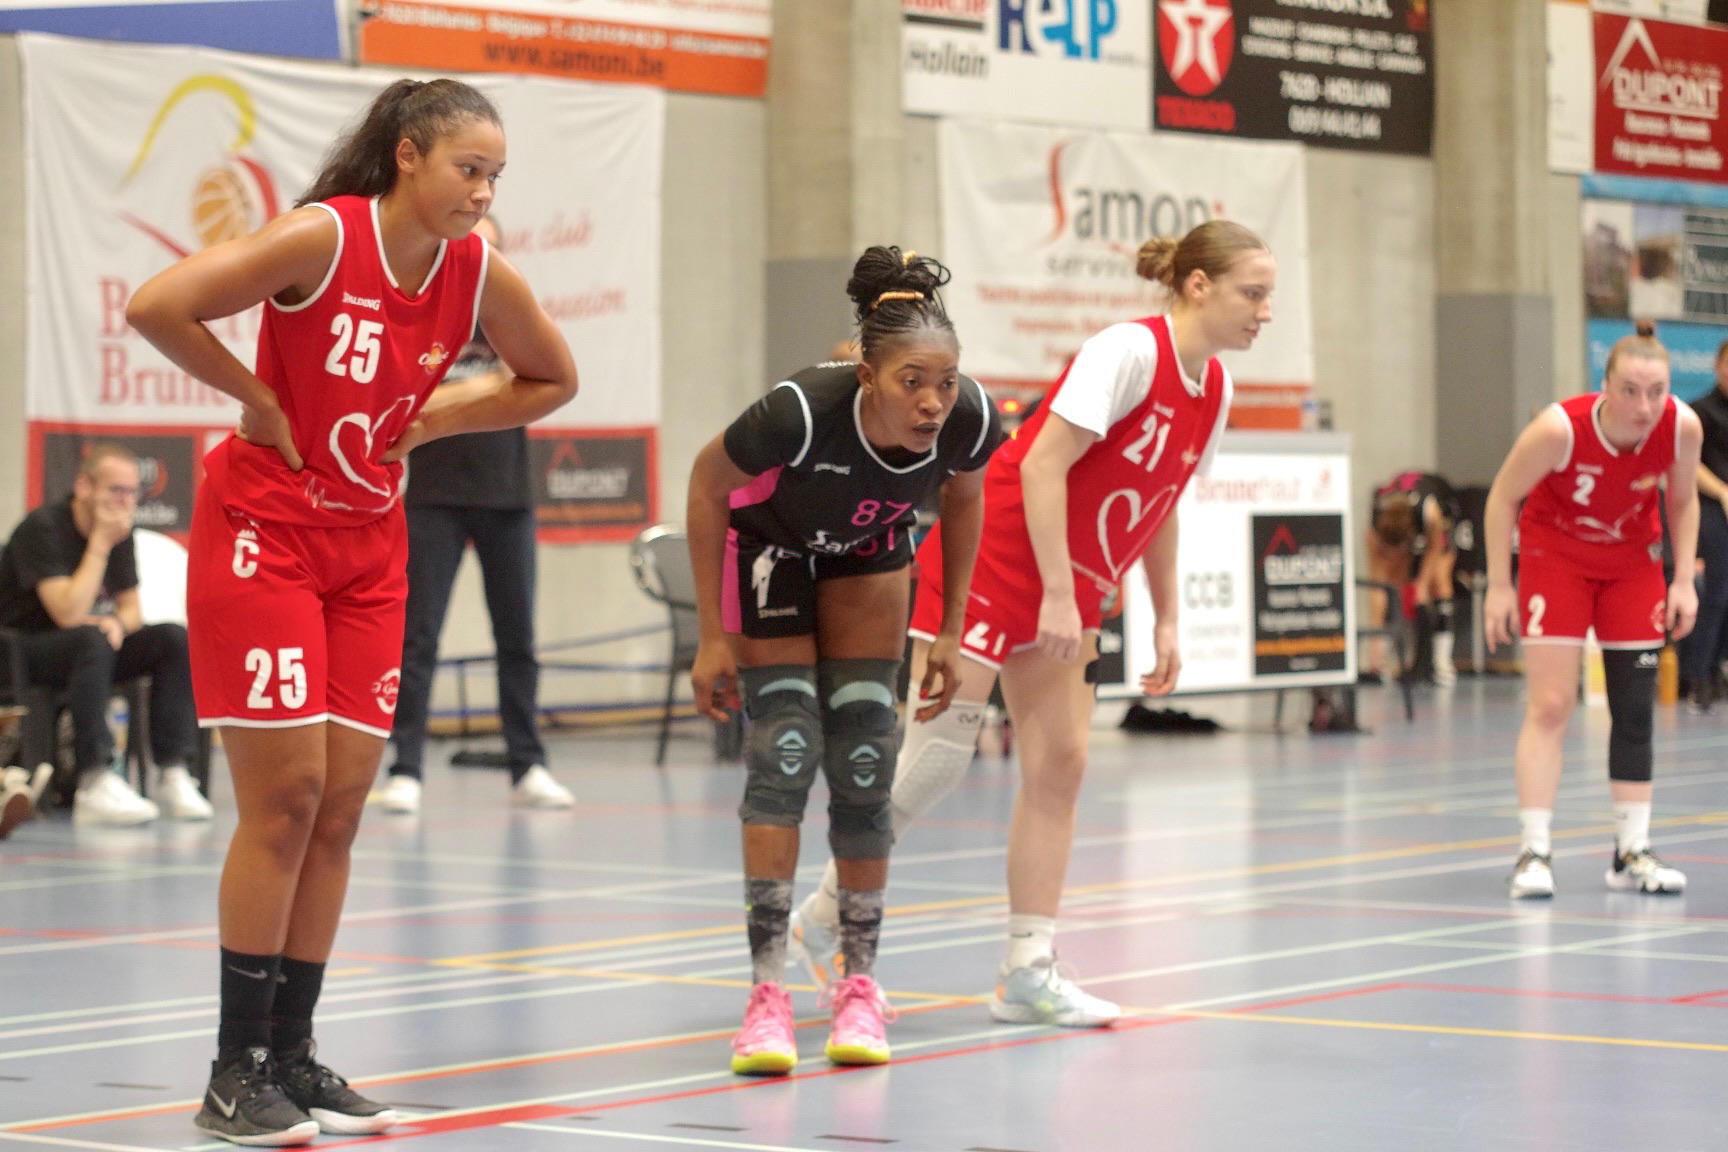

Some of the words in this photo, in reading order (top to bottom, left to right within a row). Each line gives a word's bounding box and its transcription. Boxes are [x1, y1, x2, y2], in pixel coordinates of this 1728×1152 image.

[1613, 67, 1722, 114] DUPONT
[1045, 140, 1224, 246] Samon
[343, 292, 381, 311] SPALDING
[325, 312, 384, 384] 25
[1122, 413, 1171, 472] 21
[851, 499, 912, 526] 87
[1572, 473, 1595, 506] 2
[1527, 594, 1546, 636] 2
[245, 647, 307, 709] 25
